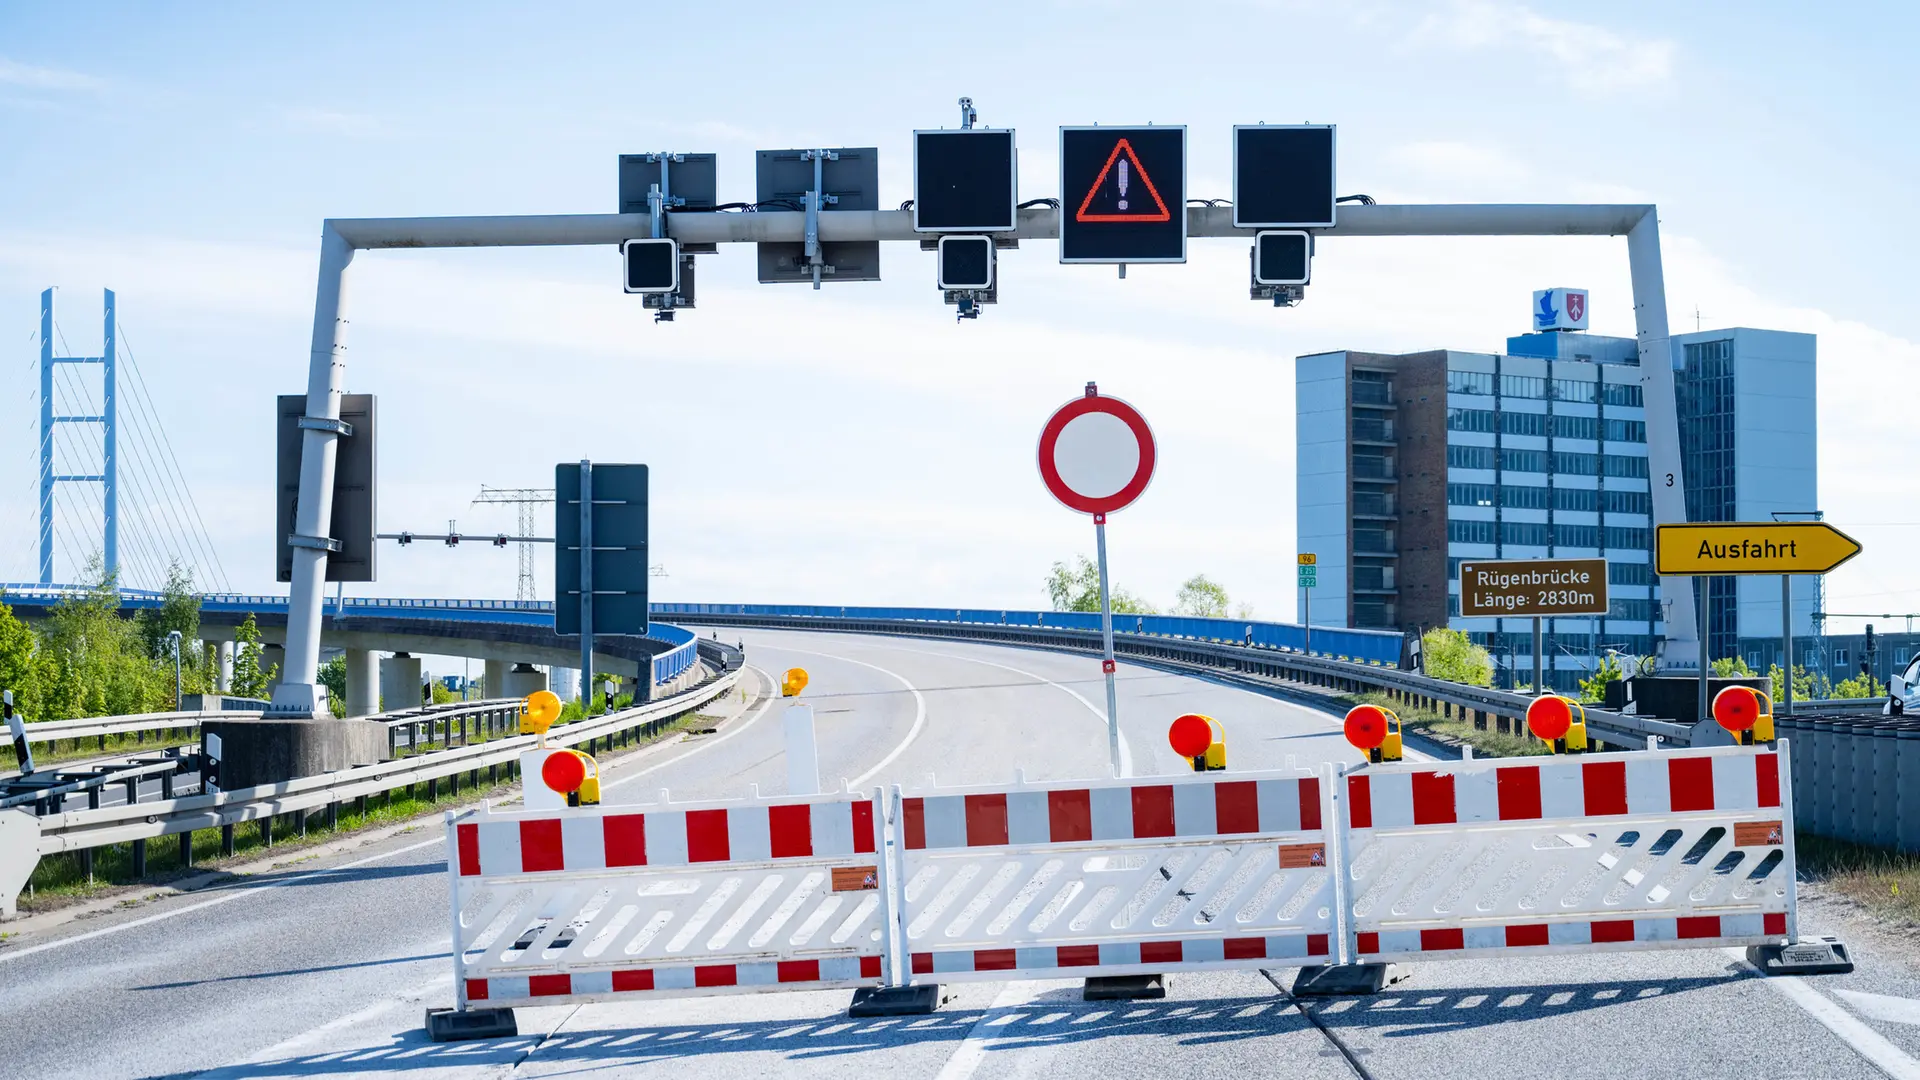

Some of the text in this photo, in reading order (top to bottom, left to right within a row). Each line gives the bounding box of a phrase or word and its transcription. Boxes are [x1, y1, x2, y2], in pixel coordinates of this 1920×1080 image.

[1665, 473, 1674, 488] 3
[1697, 538, 1797, 559] Ausfahrt
[1302, 555, 1312, 563] 96
[1478, 569, 1590, 589] Rügenbrücke
[1474, 590, 1595, 610] Länge: 2830m
